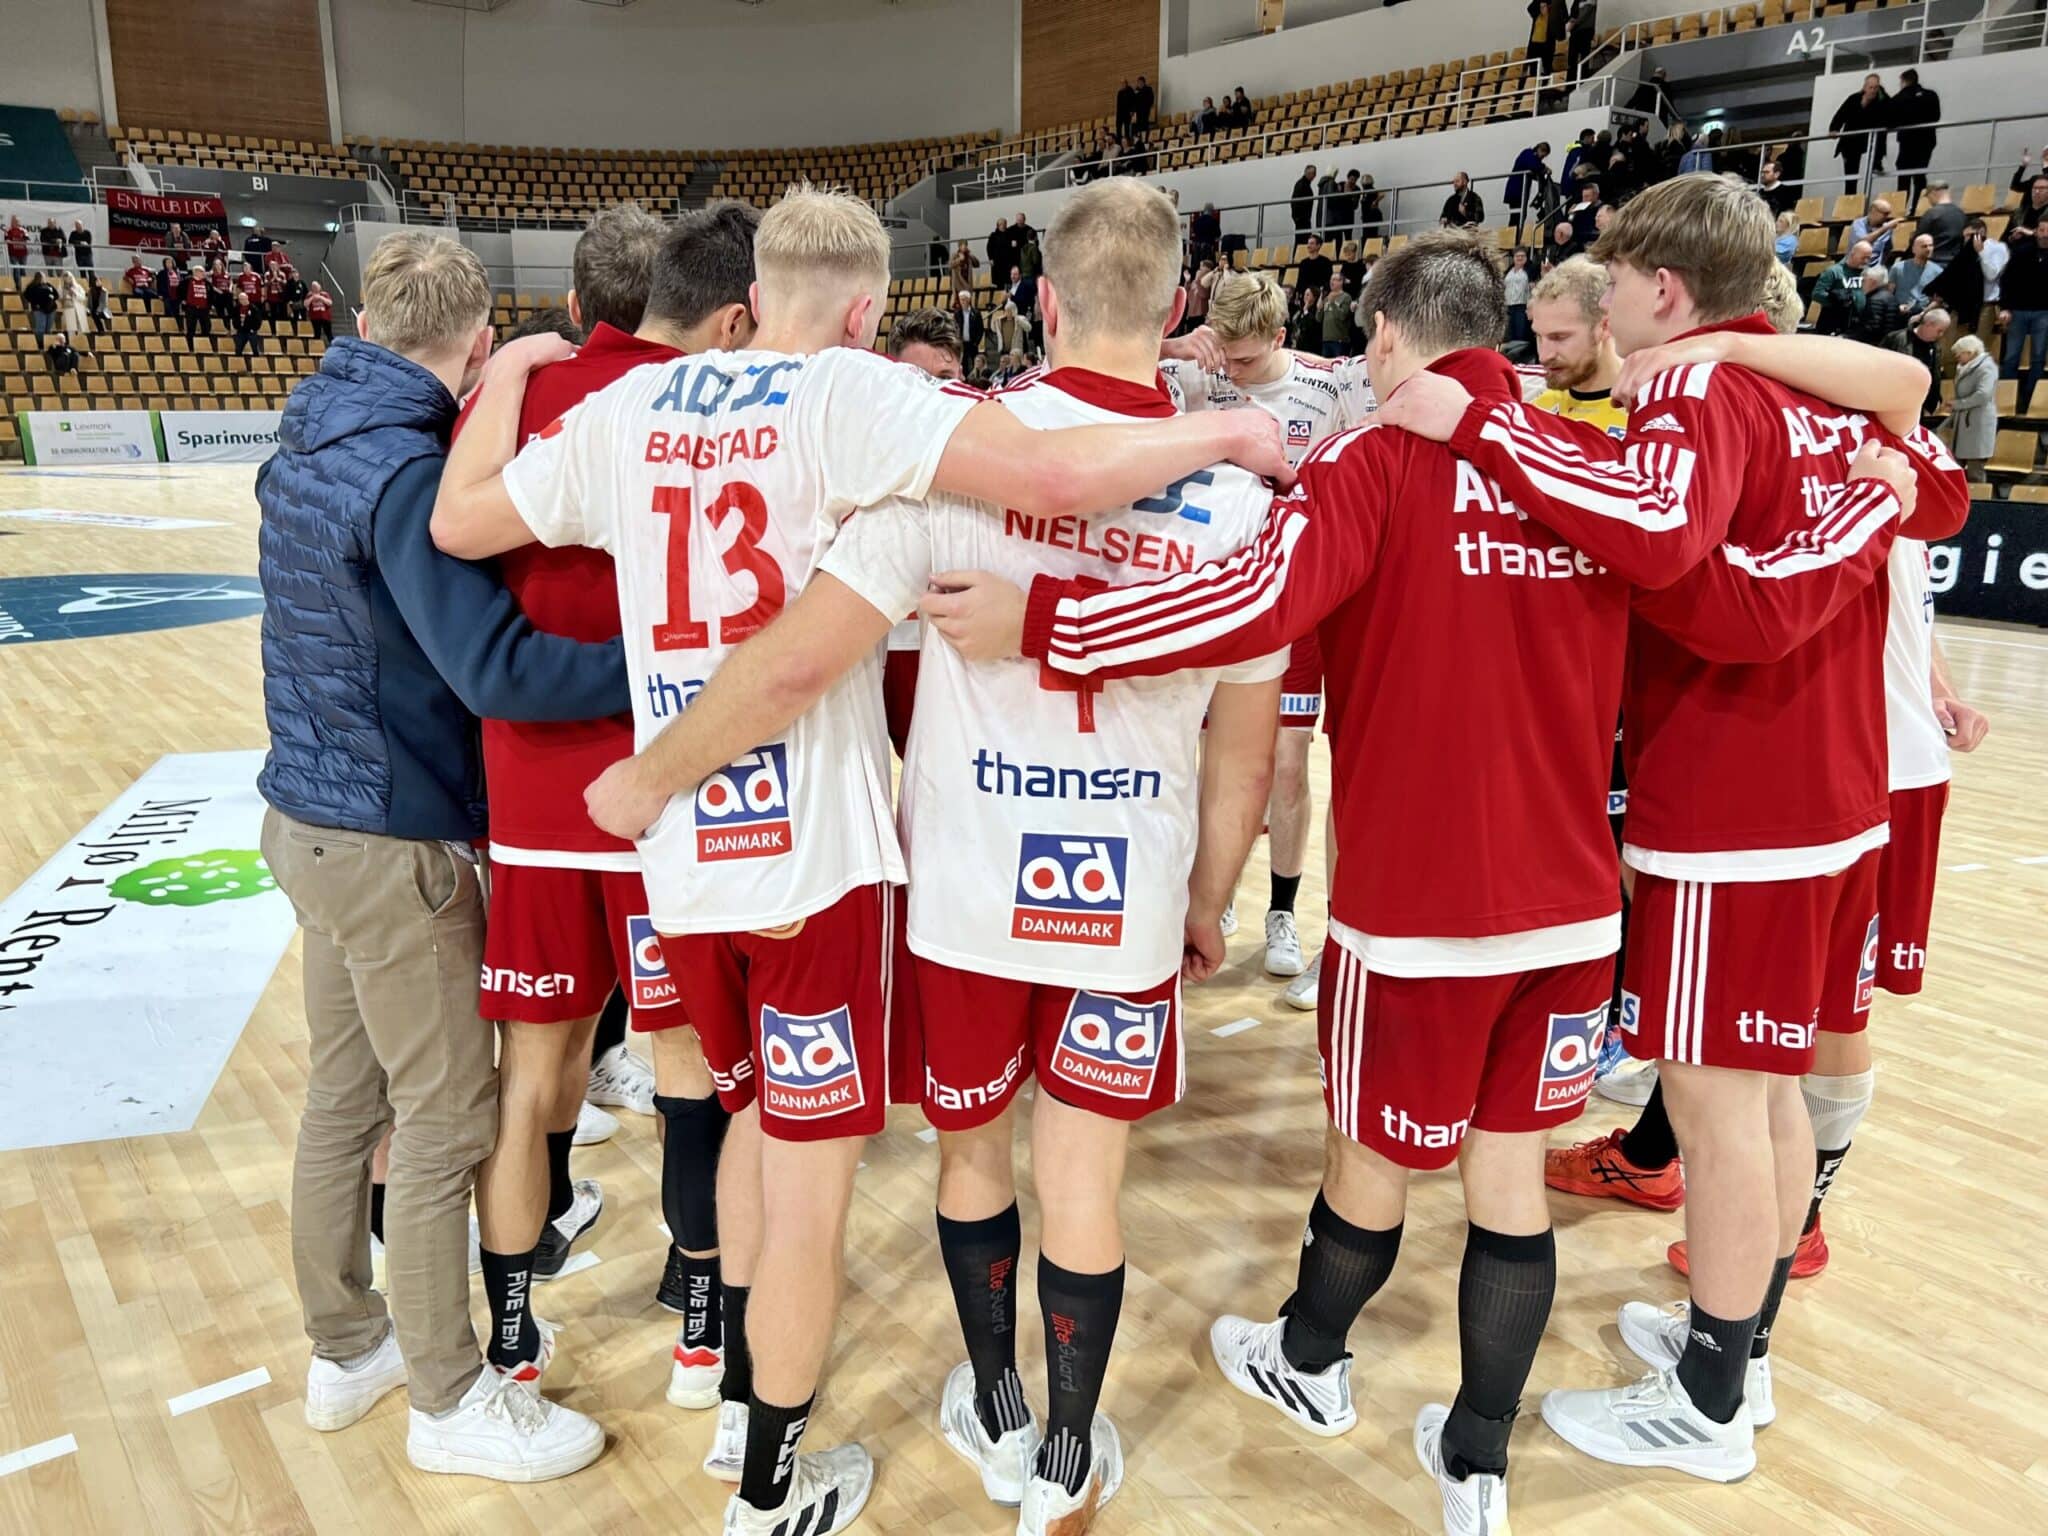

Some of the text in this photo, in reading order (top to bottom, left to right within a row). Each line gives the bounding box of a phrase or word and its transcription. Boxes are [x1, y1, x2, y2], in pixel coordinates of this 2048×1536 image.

[1786, 27, 1825, 55] A2
[117, 192, 138, 210] EN
[143, 198, 181, 214] KLUB
[193, 200, 213, 214] DK
[177, 430, 280, 448] Sparinvest
[651, 481, 787, 651] 13
[1005, 508, 1194, 573] NIELSEN
[1454, 531, 1607, 579] thanse
[698, 752, 787, 818] ad
[972, 749, 1161, 800] thansen
[704, 831, 784, 853] DANMARK
[1021, 841, 1122, 903] ad
[1021, 916, 1114, 938] DANMARK
[766, 1021, 851, 1077] ad
[1070, 1005, 1155, 1060] ad
[770, 1085, 852, 1110] DANMARK
[1062, 1056, 1144, 1088] DANMARK
[501, 1270, 528, 1350] FIVE TEN
[687, 1275, 710, 1340] FIVE TEN
